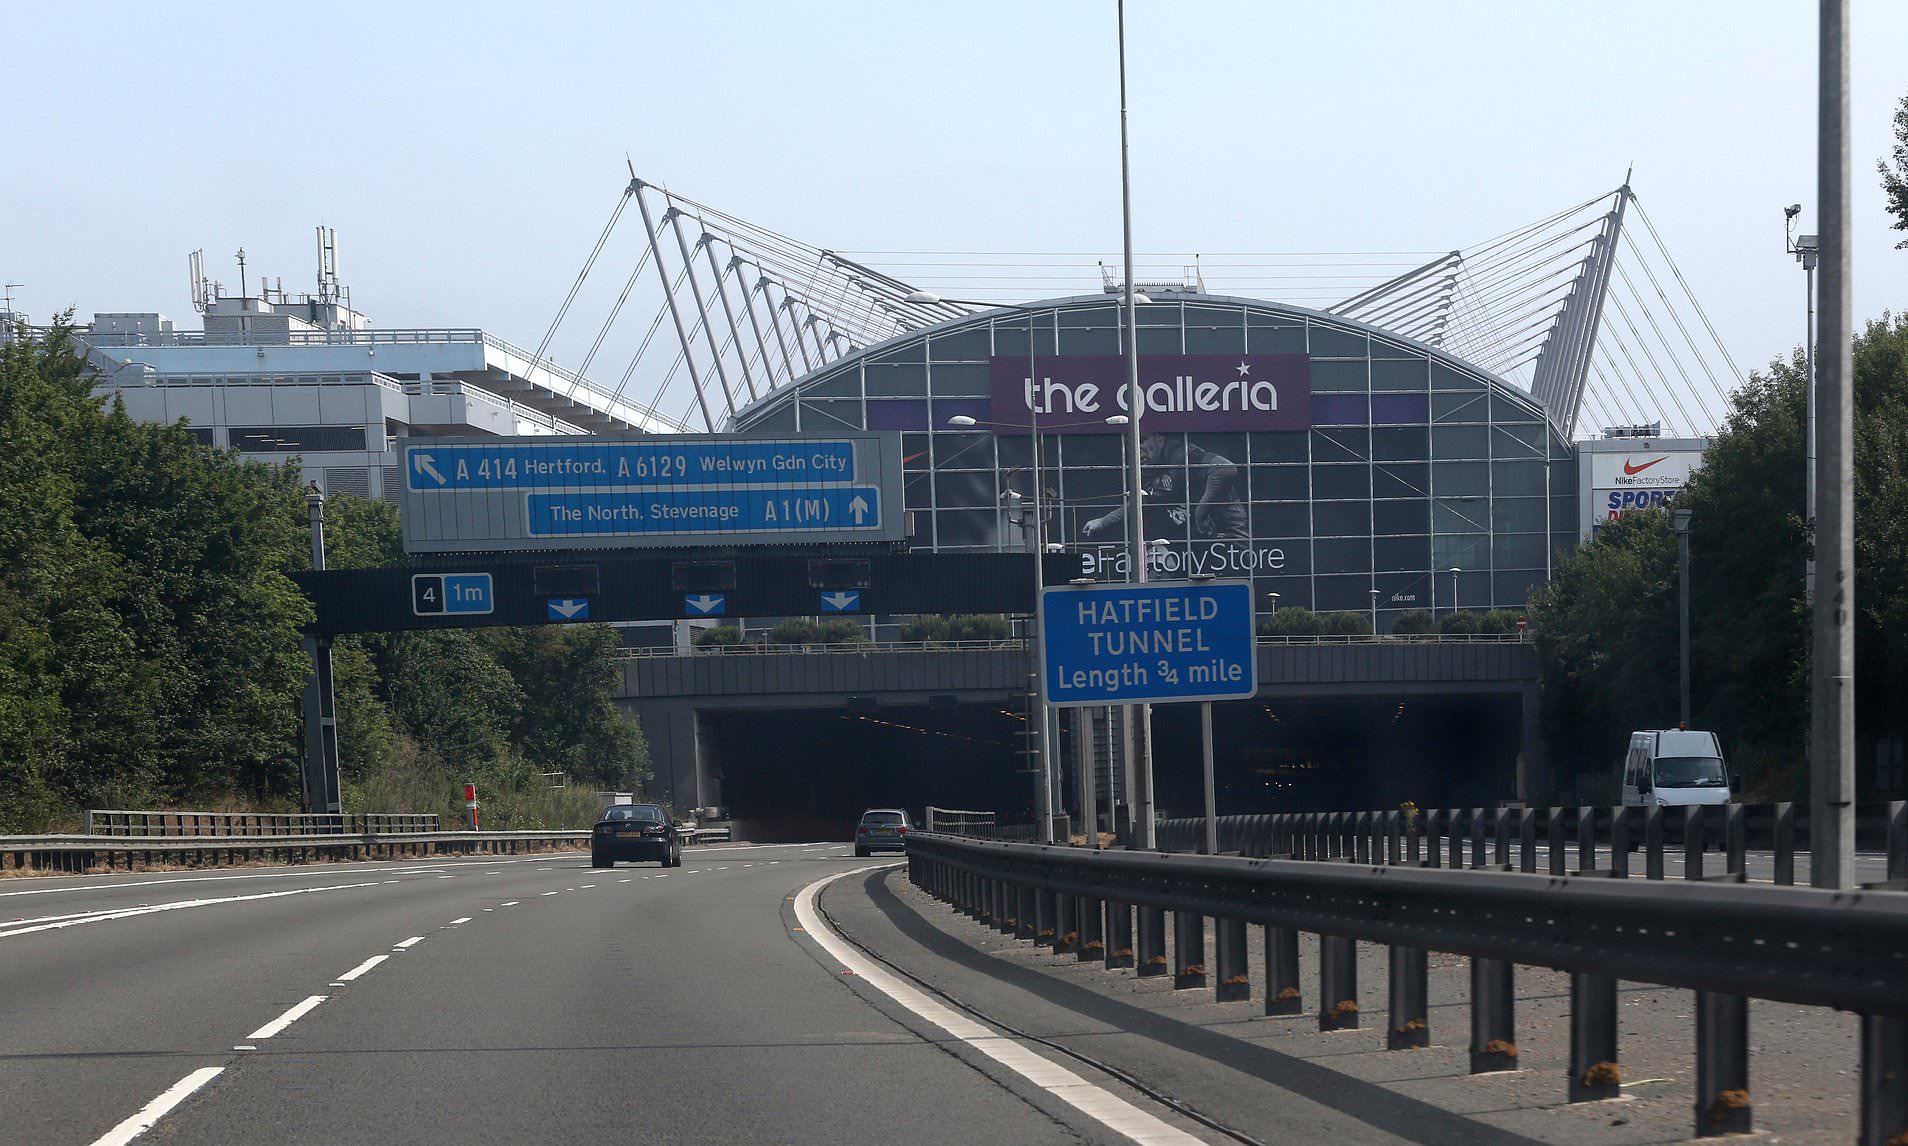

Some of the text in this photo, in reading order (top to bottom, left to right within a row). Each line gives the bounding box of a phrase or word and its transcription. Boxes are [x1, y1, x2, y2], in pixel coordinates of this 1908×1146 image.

[1024, 377, 1100, 414] the
[456, 458, 470, 481] A
[478, 456, 519, 481] 414
[618, 456, 630, 478] A
[636, 454, 687, 478] 6129
[699, 454, 767, 474] Welwyn
[772, 453, 807, 471] Gdn
[812, 453, 847, 474] City
[1615, 475, 1680, 486] NikeFactoryStore
[550, 505, 582, 521] The
[650, 503, 740, 523] Stevenage
[422, 584, 483, 603] 4 1m
[1078, 596, 1218, 625] HATFIELD
[1088, 628, 1210, 656] TUNNEL
[1058, 661, 1147, 692] Length
[1188, 658, 1243, 683] mile
